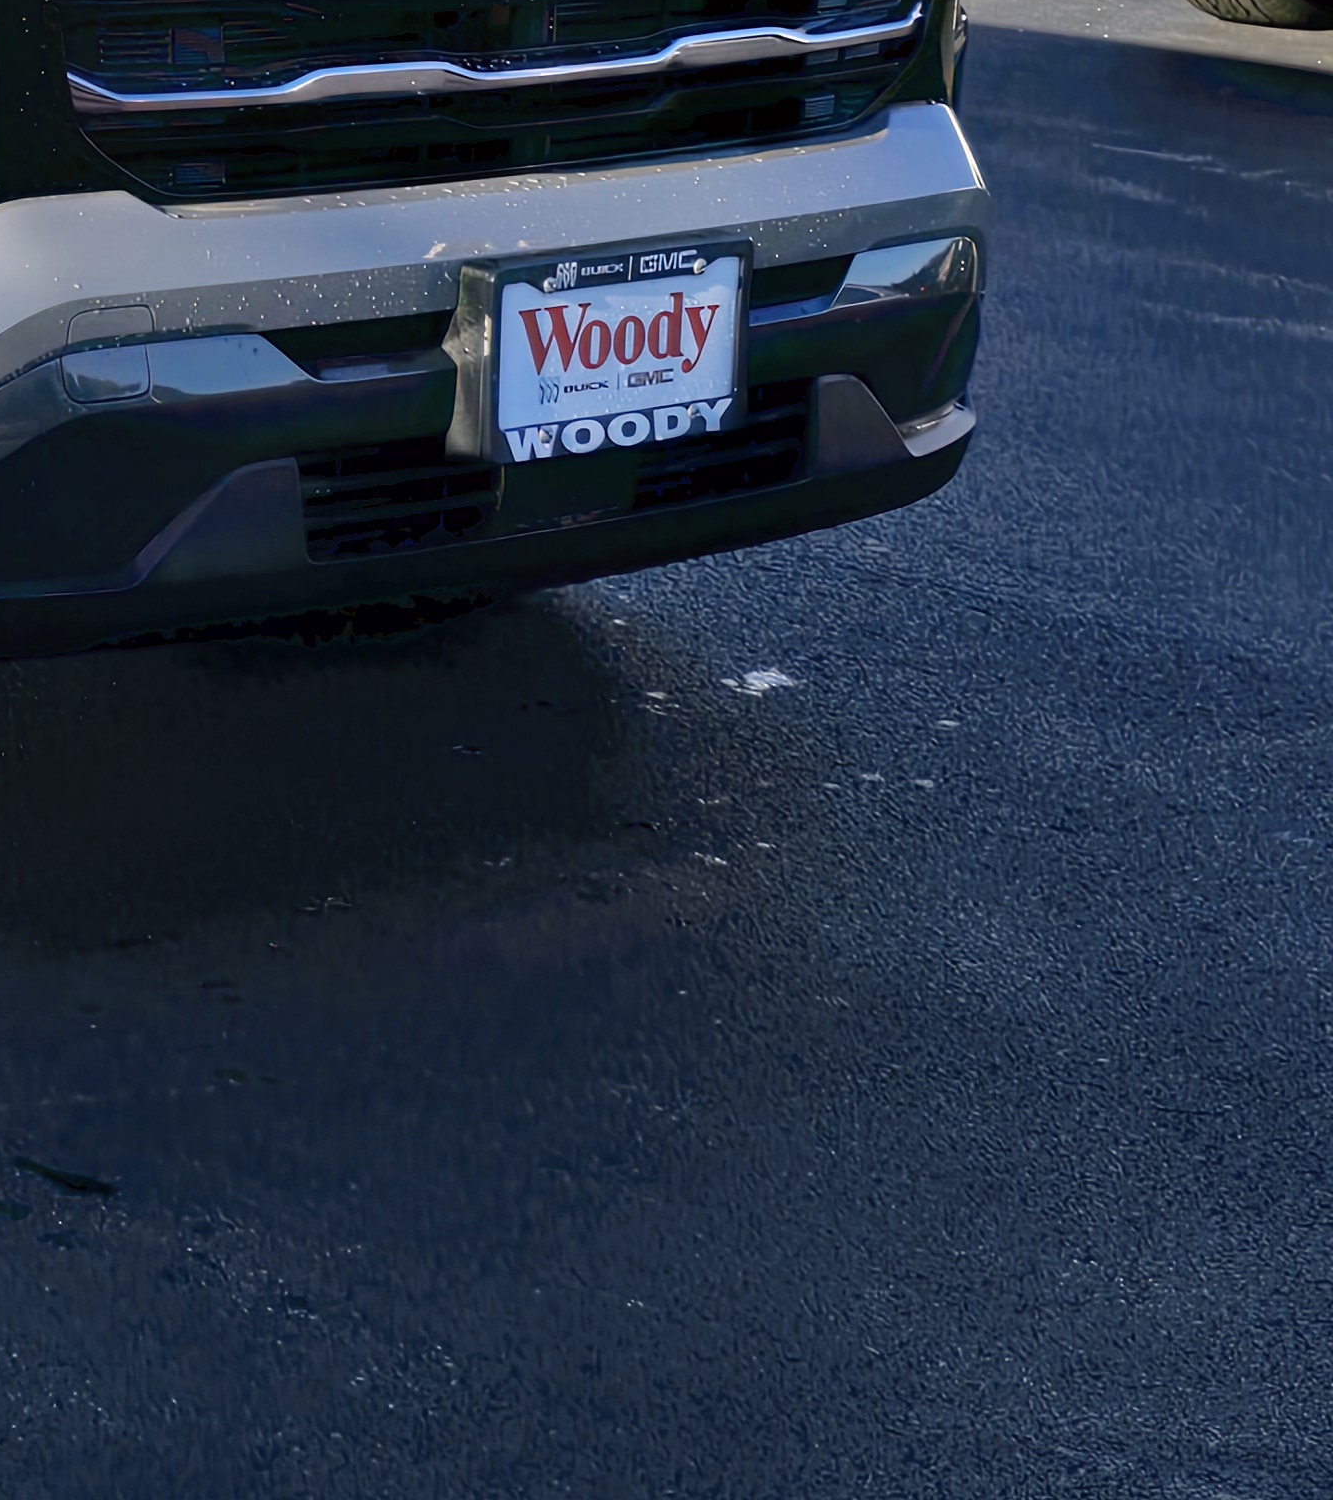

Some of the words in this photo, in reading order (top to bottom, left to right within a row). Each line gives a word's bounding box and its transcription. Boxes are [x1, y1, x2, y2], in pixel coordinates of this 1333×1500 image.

[639, 249, 698, 275] GMC
[519, 291, 721, 377] Woody
[626, 367, 675, 389] GMC
[504, 397, 733, 463] WOODY
